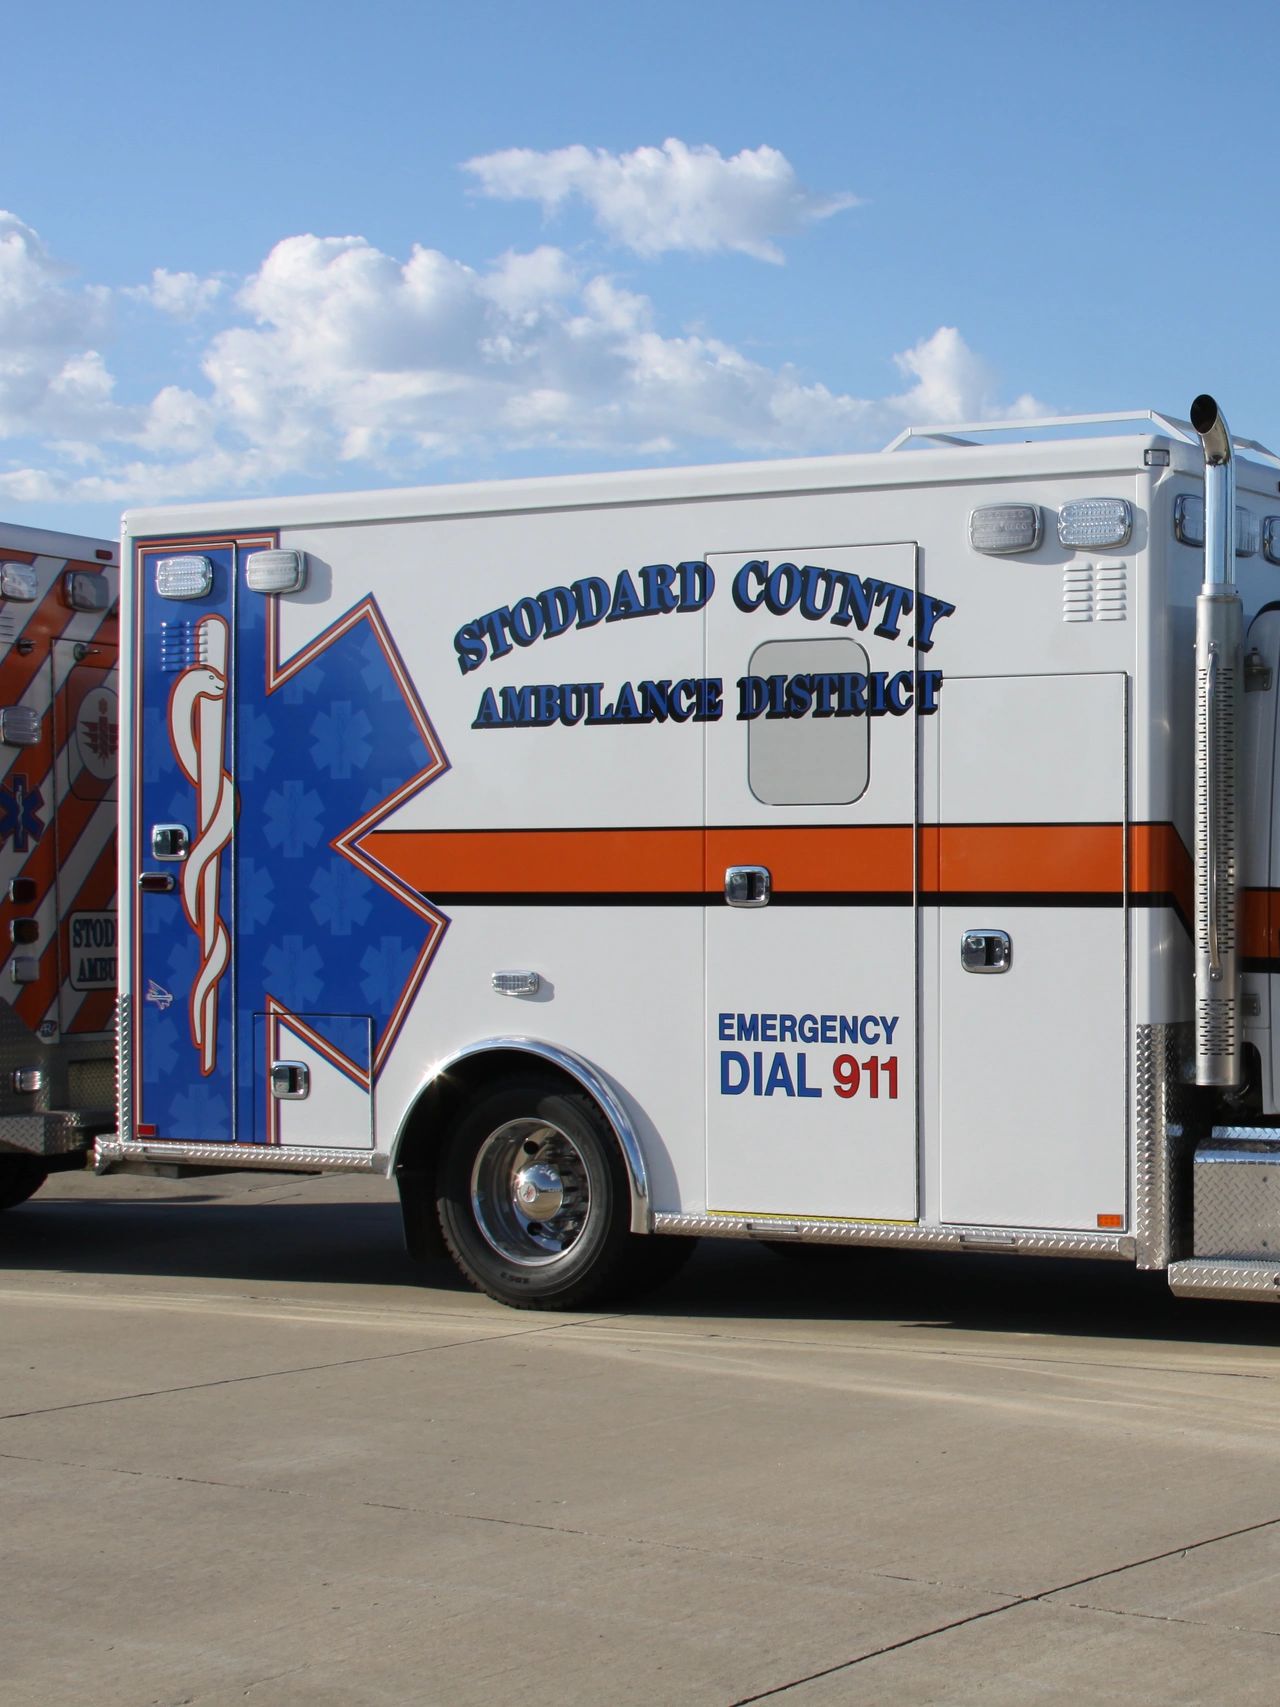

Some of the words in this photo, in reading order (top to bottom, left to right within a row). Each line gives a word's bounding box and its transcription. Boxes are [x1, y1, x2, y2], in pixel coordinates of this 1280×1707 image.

[453, 560, 716, 675] STODDARD
[731, 560, 956, 653] COUNTY
[471, 678, 724, 730] AMBULANCE
[736, 670, 943, 721] DISTRICT
[72, 918, 118, 948] STOD
[718, 1012, 900, 1045] EMERGENCY
[720, 1050, 823, 1098] DIAL
[832, 1053, 898, 1099] 911
